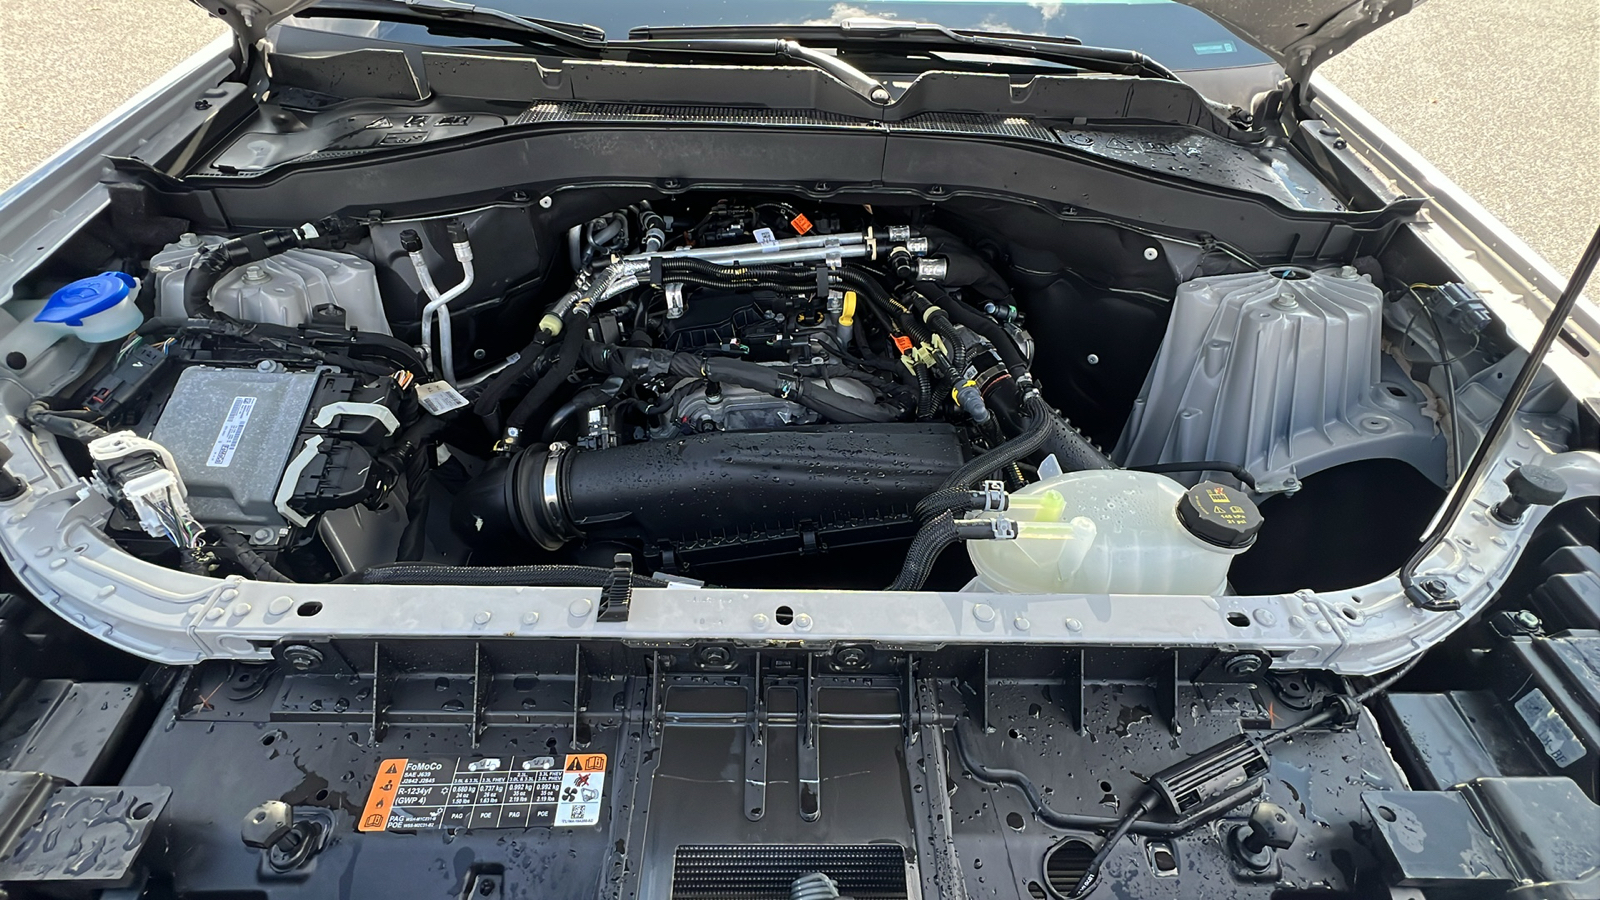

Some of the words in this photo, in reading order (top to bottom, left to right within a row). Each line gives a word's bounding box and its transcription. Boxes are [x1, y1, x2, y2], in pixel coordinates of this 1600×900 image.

[405, 762, 443, 771] FoMoCo
[468, 785, 476, 793] kg
[496, 785, 504, 793] kg
[525, 783, 533, 791] kg
[398, 787, 433, 796] R-1234yf
[395, 797, 418, 806] (GWP
[418, 797, 427, 805] 4)
